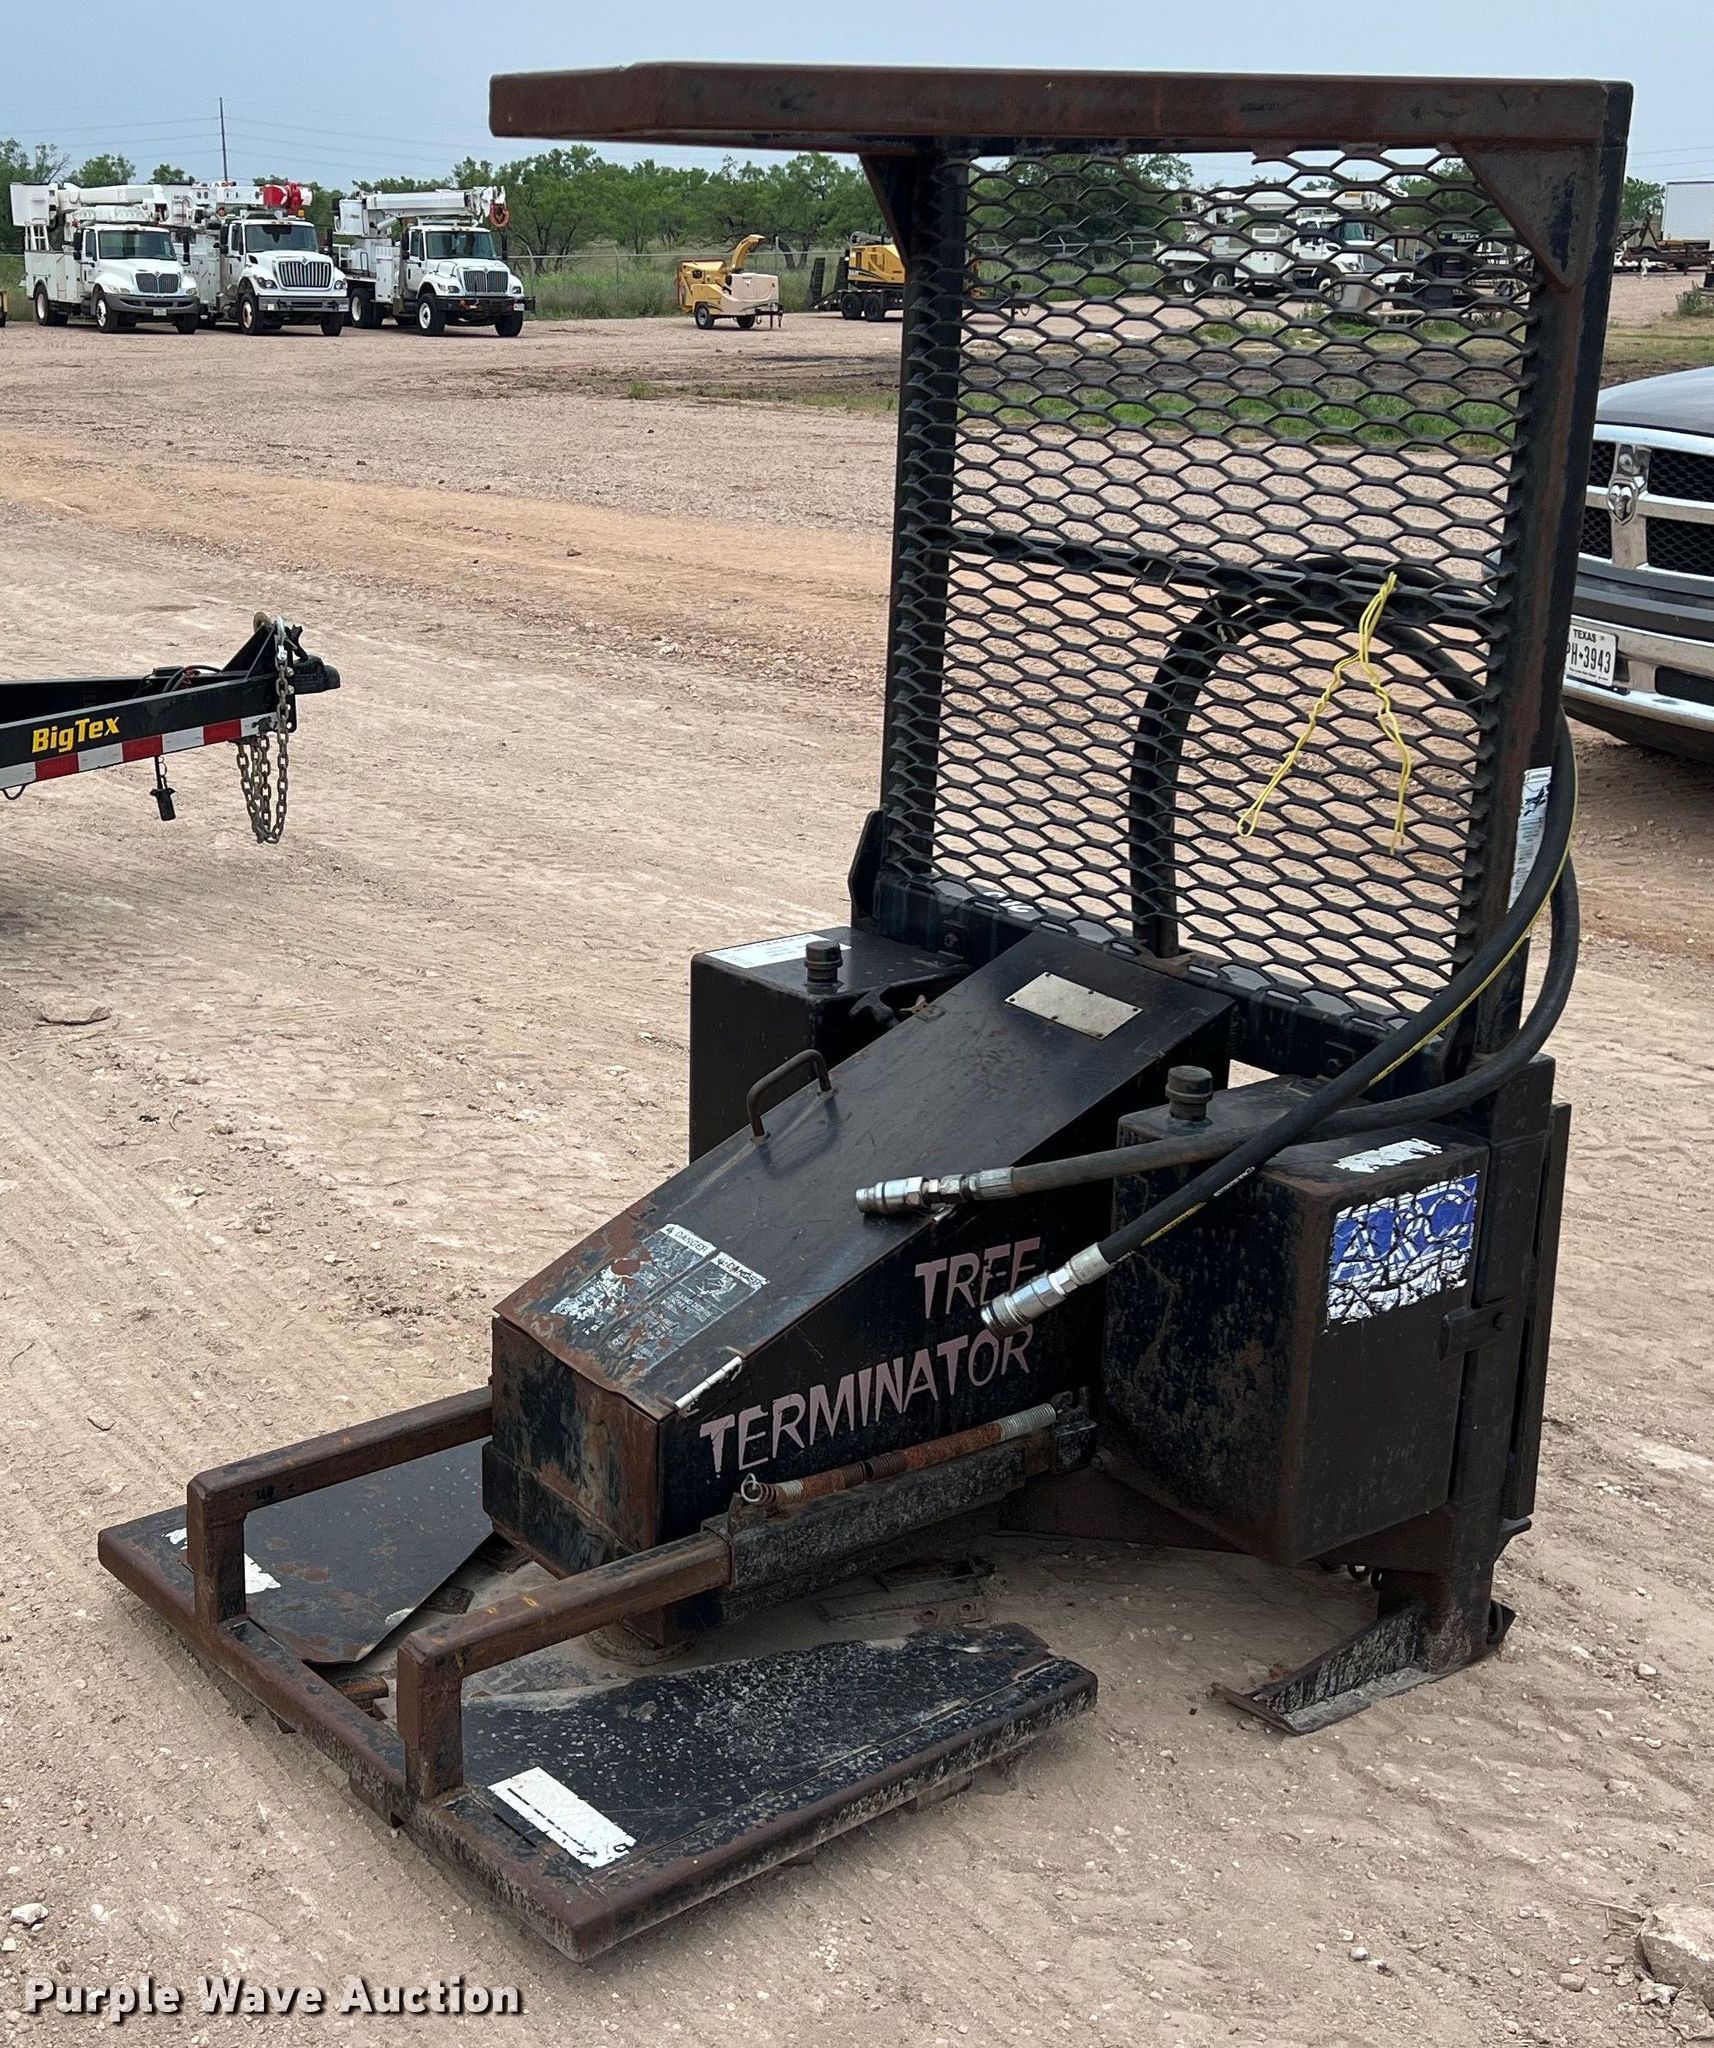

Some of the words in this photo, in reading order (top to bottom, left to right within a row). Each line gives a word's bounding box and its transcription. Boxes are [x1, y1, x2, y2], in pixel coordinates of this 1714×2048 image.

[1573, 628, 1597, 643] TEXAS
[32, 716, 120, 753] BigTex
[675, 1230, 709, 1253] DANGER
[700, 1322, 1034, 1475] TERMINATOR
